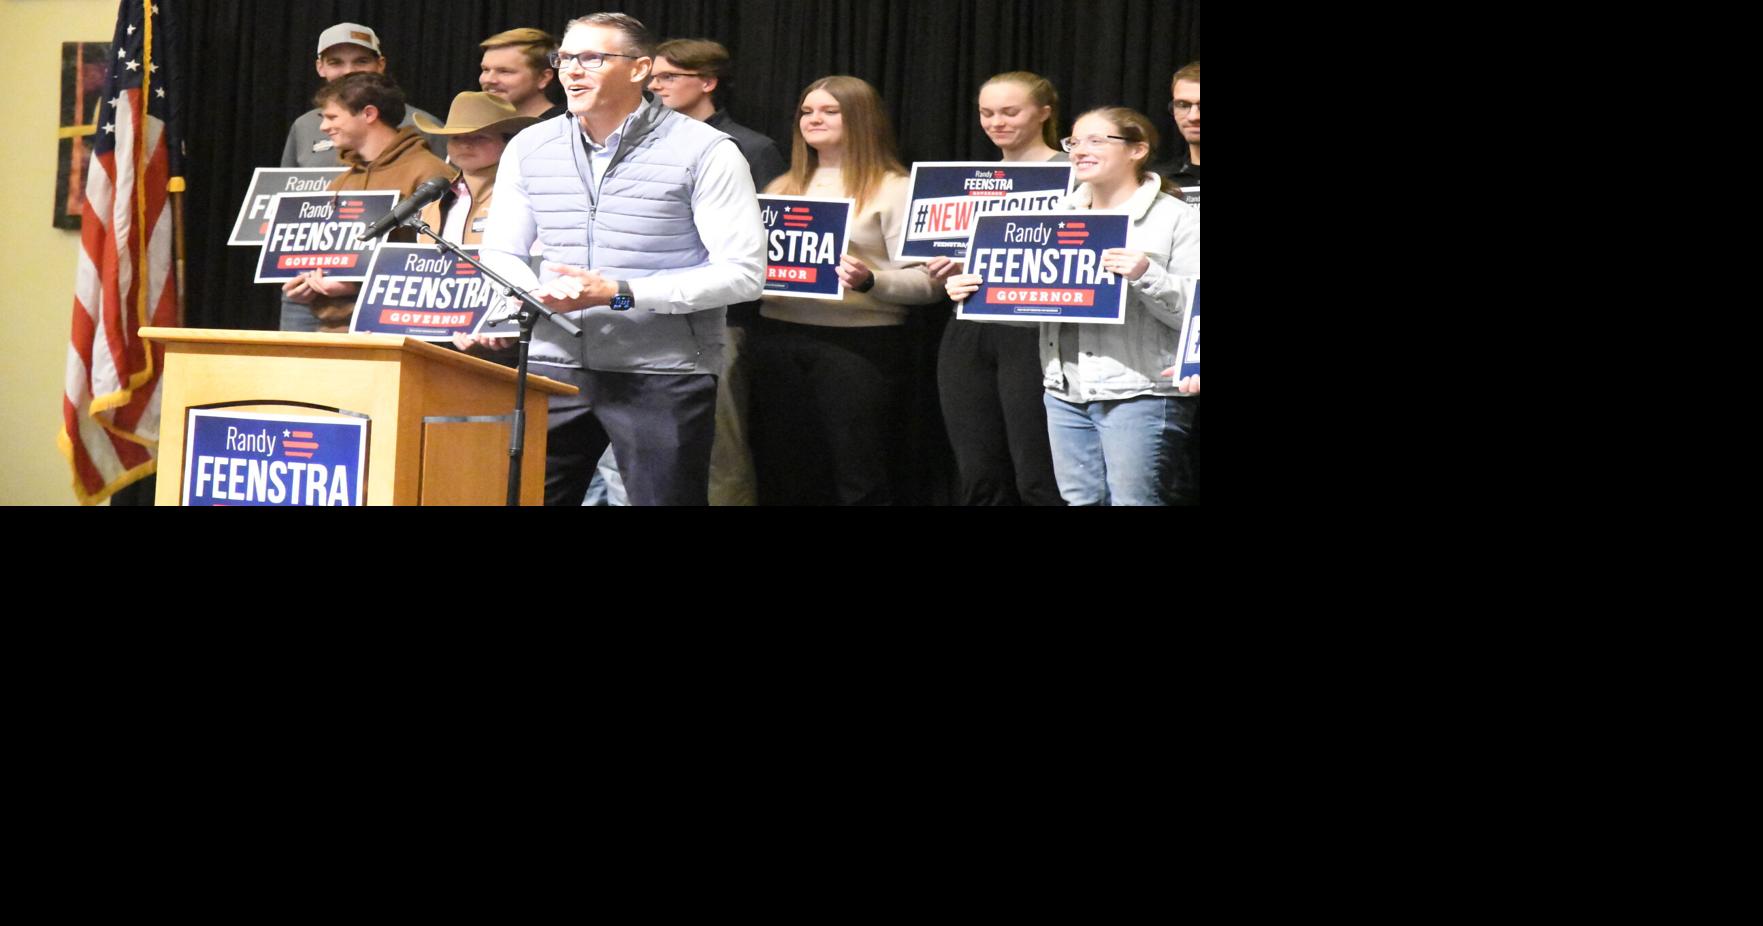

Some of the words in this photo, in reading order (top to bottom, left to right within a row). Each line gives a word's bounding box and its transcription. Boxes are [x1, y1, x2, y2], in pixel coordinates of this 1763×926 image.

[285, 176, 332, 191] Randy
[964, 178, 1013, 191] FEENSTRA
[299, 202, 334, 219] Randy
[1004, 222, 1052, 246] Randy
[765, 229, 835, 265] STRA
[285, 256, 349, 267] GOVERNOR
[404, 253, 452, 276] Randy
[974, 248, 1115, 285] FEENSTRA
[768, 268, 807, 280] RNOR
[367, 274, 488, 309] FEENSTRA
[996, 290, 1084, 303] GOVERNOR
[390, 312, 466, 324] GOVERNOR
[226, 426, 276, 457] Randy
[196, 455, 350, 506] FEENSTRA
